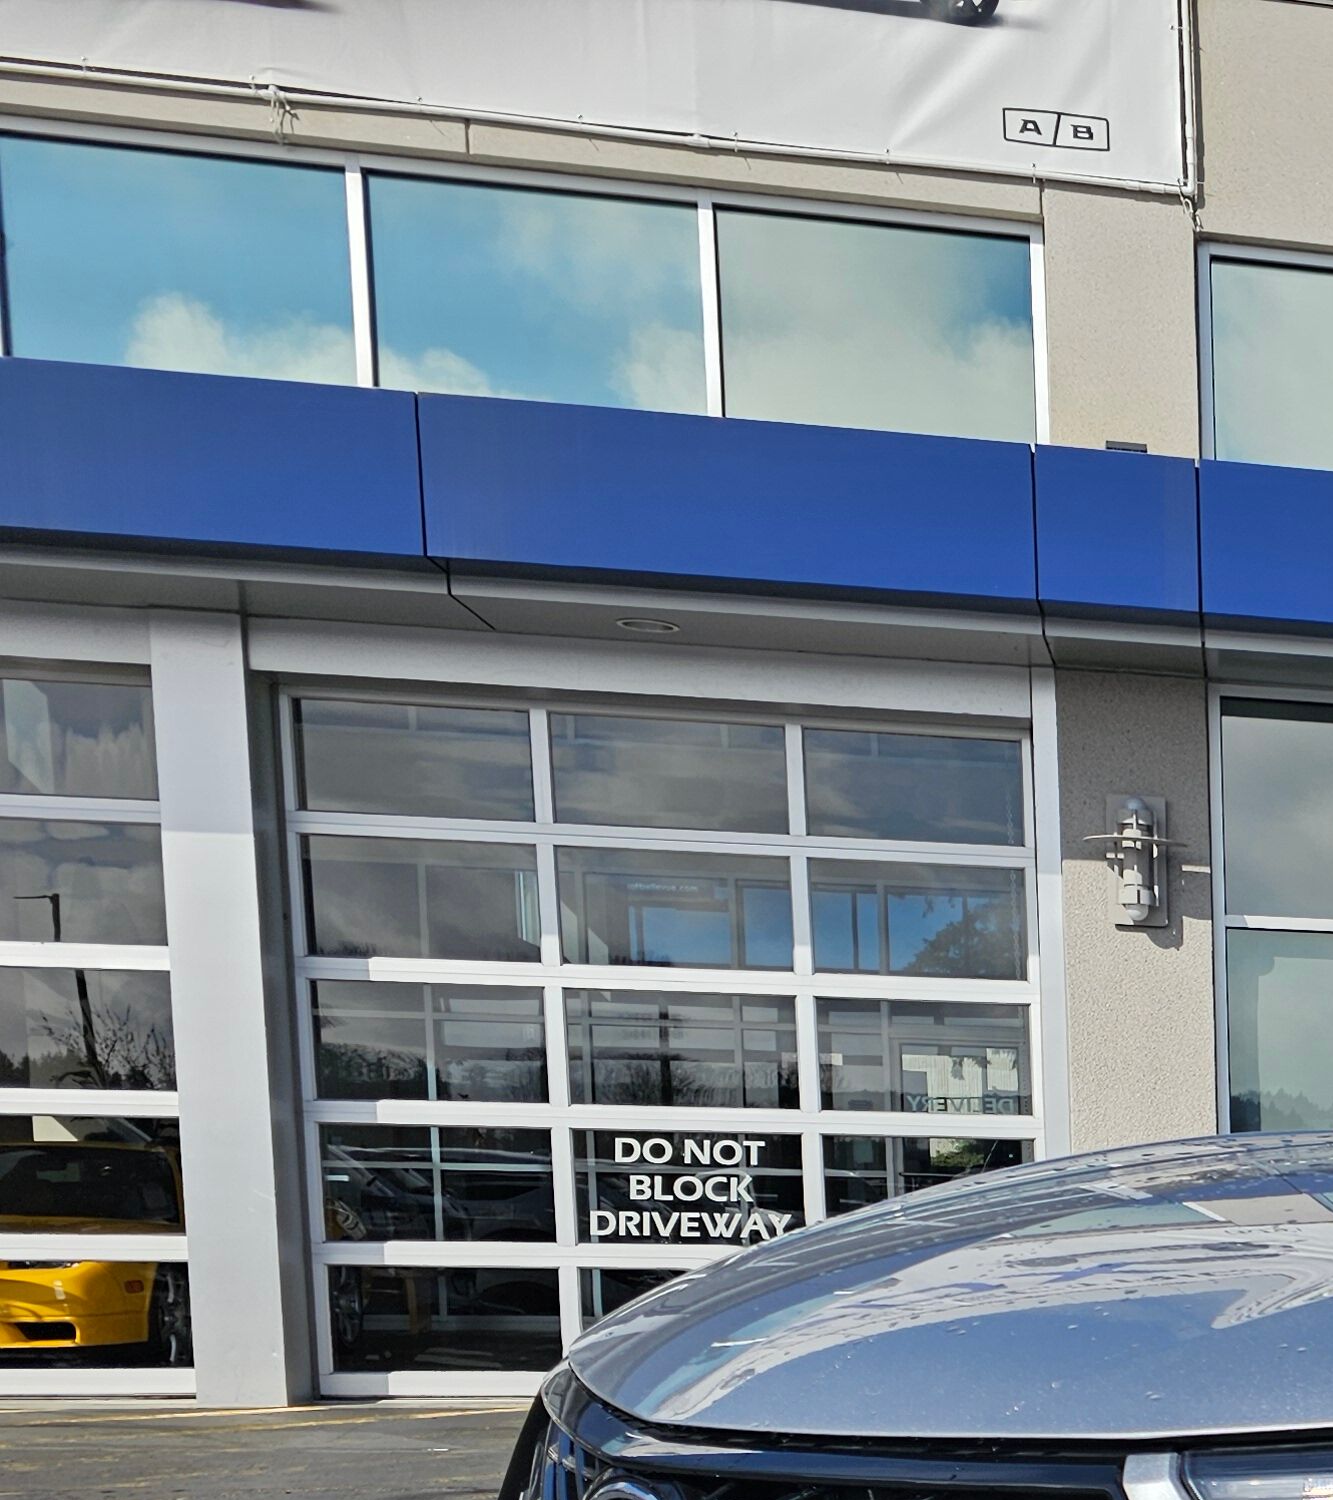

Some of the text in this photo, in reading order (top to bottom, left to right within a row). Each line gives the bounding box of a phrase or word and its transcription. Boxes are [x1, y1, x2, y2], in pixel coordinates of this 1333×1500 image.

[614, 1137, 766, 1166] DO NOT
[628, 1174, 755, 1203] BLOCK
[589, 1210, 793, 1241] DRIVEWAY
